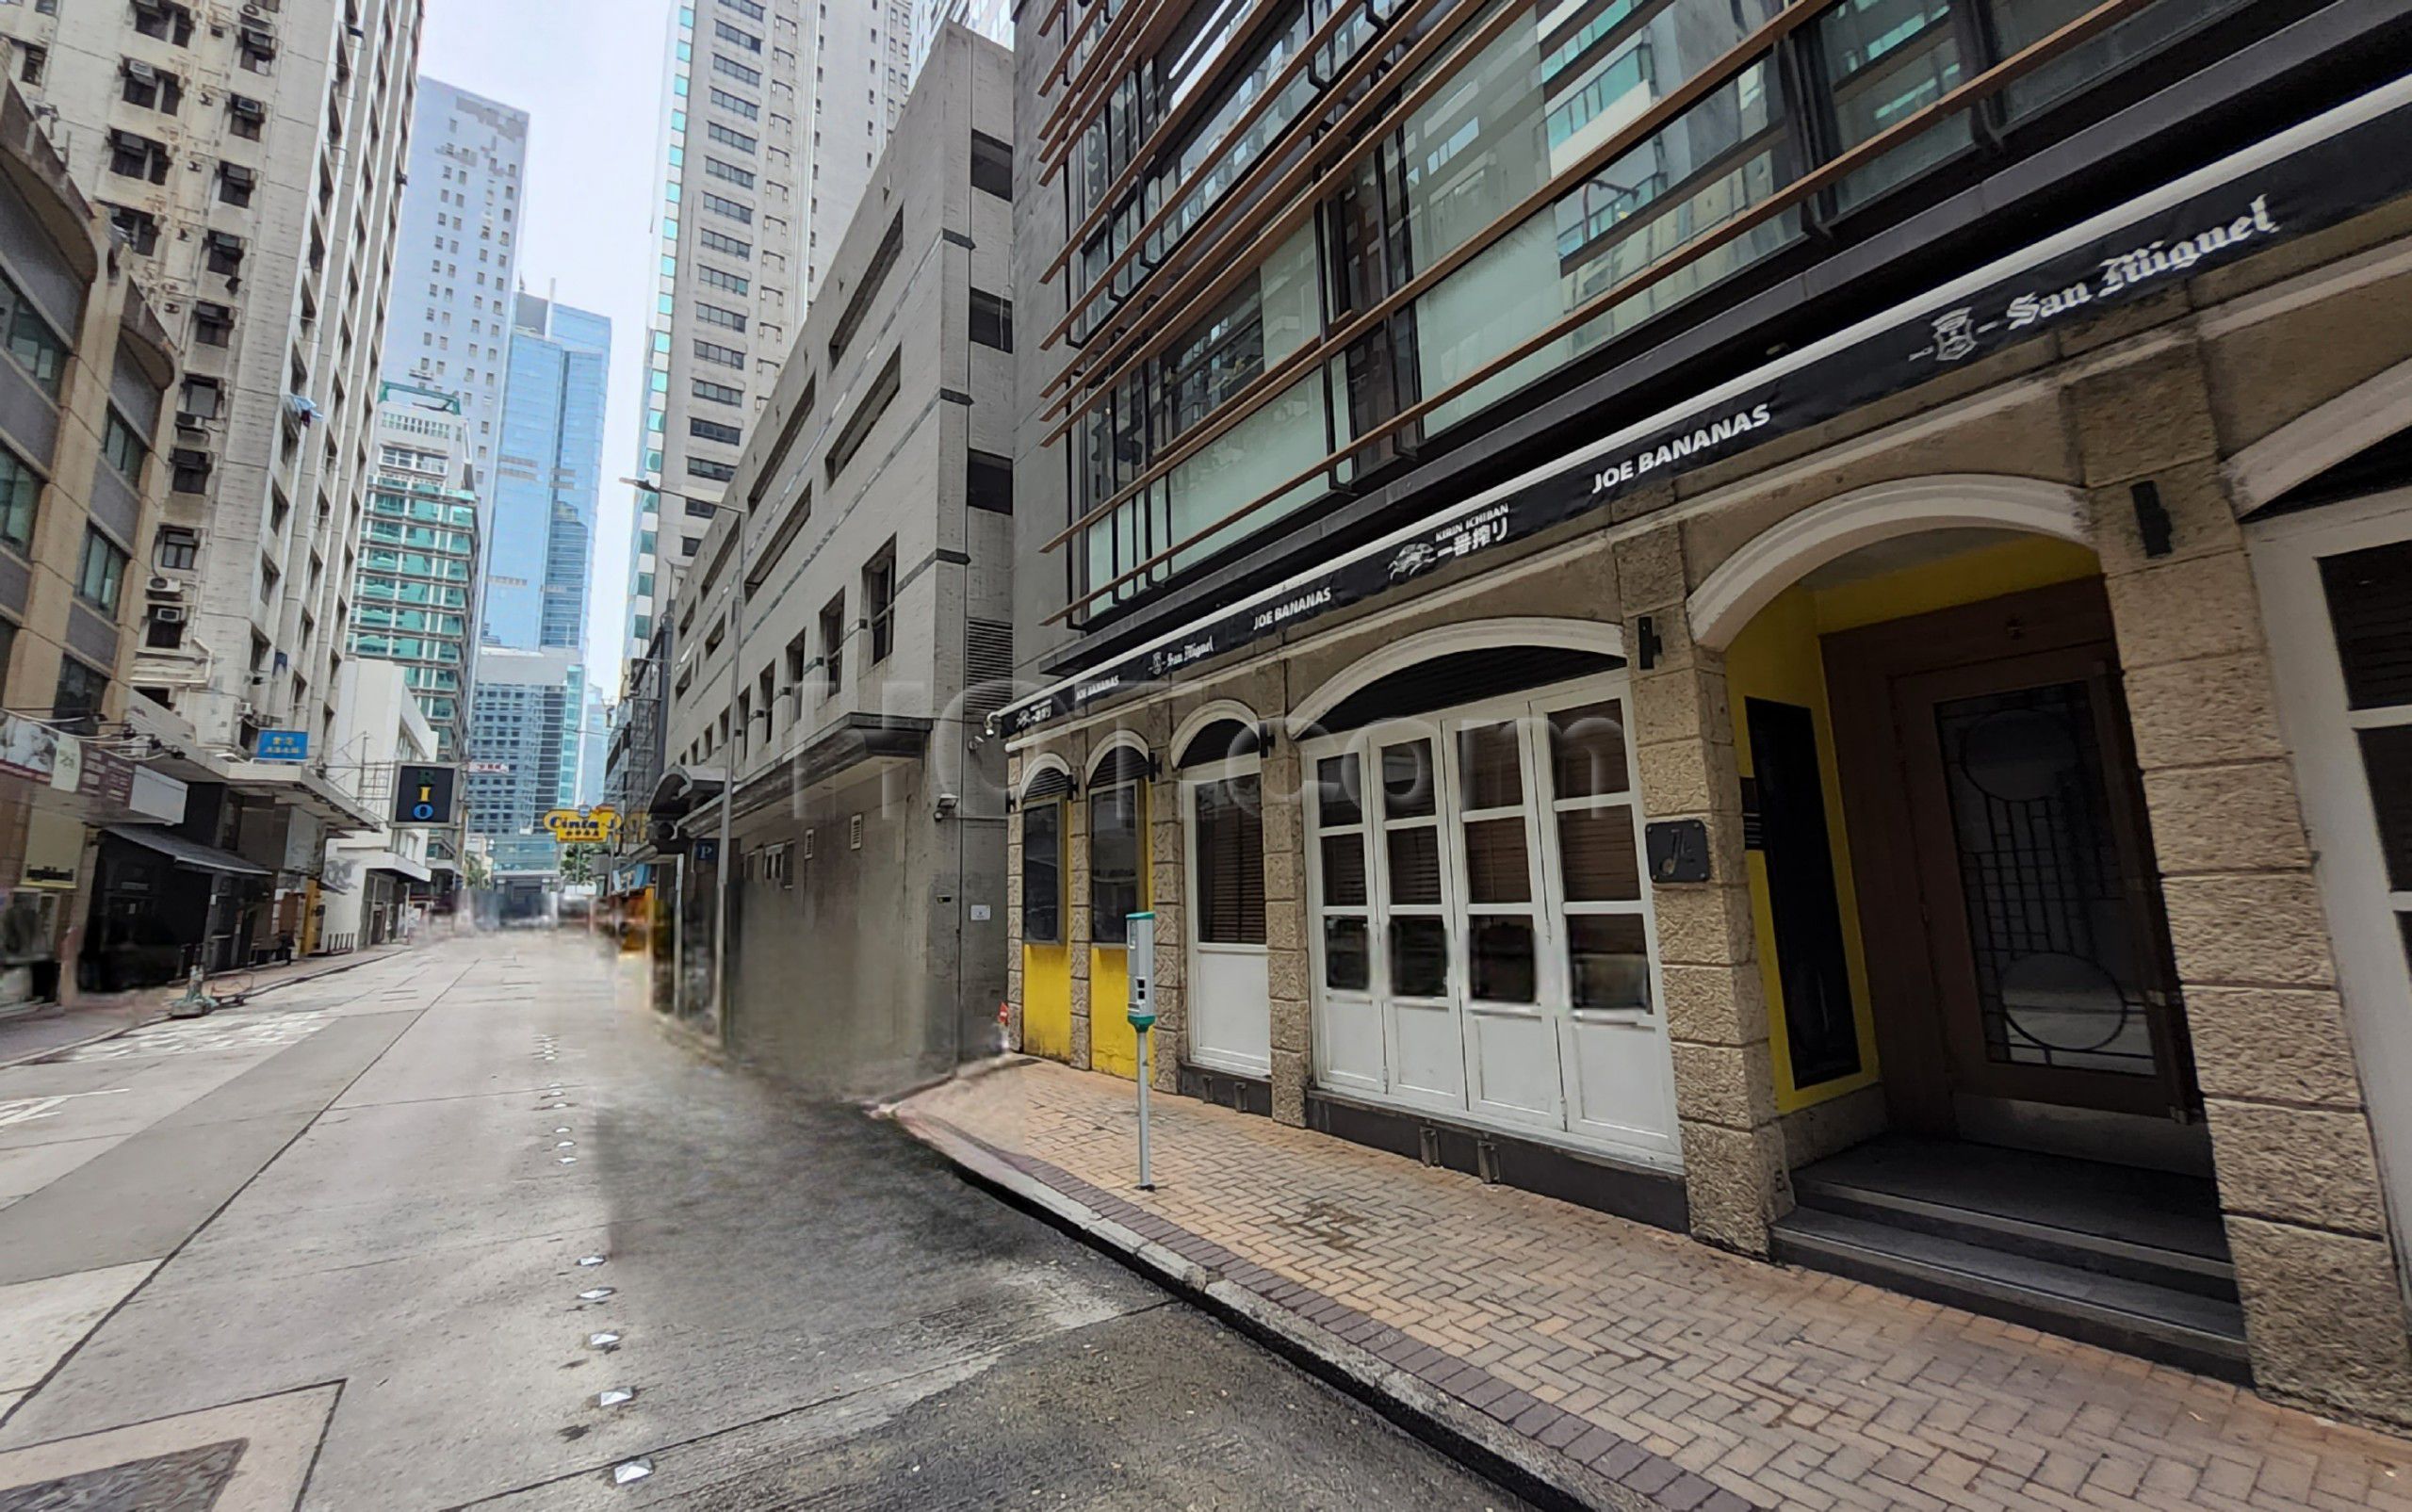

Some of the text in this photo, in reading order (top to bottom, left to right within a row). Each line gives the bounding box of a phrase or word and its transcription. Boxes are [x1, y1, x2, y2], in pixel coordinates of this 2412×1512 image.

[2007, 194, 2280, 331] San Miguel
[1591, 404, 1771, 494] JOE BANANAS
[1435, 503, 1509, 542] KIRIN ICHIBAN
[1254, 587, 1332, 630] JOE BANANAS
